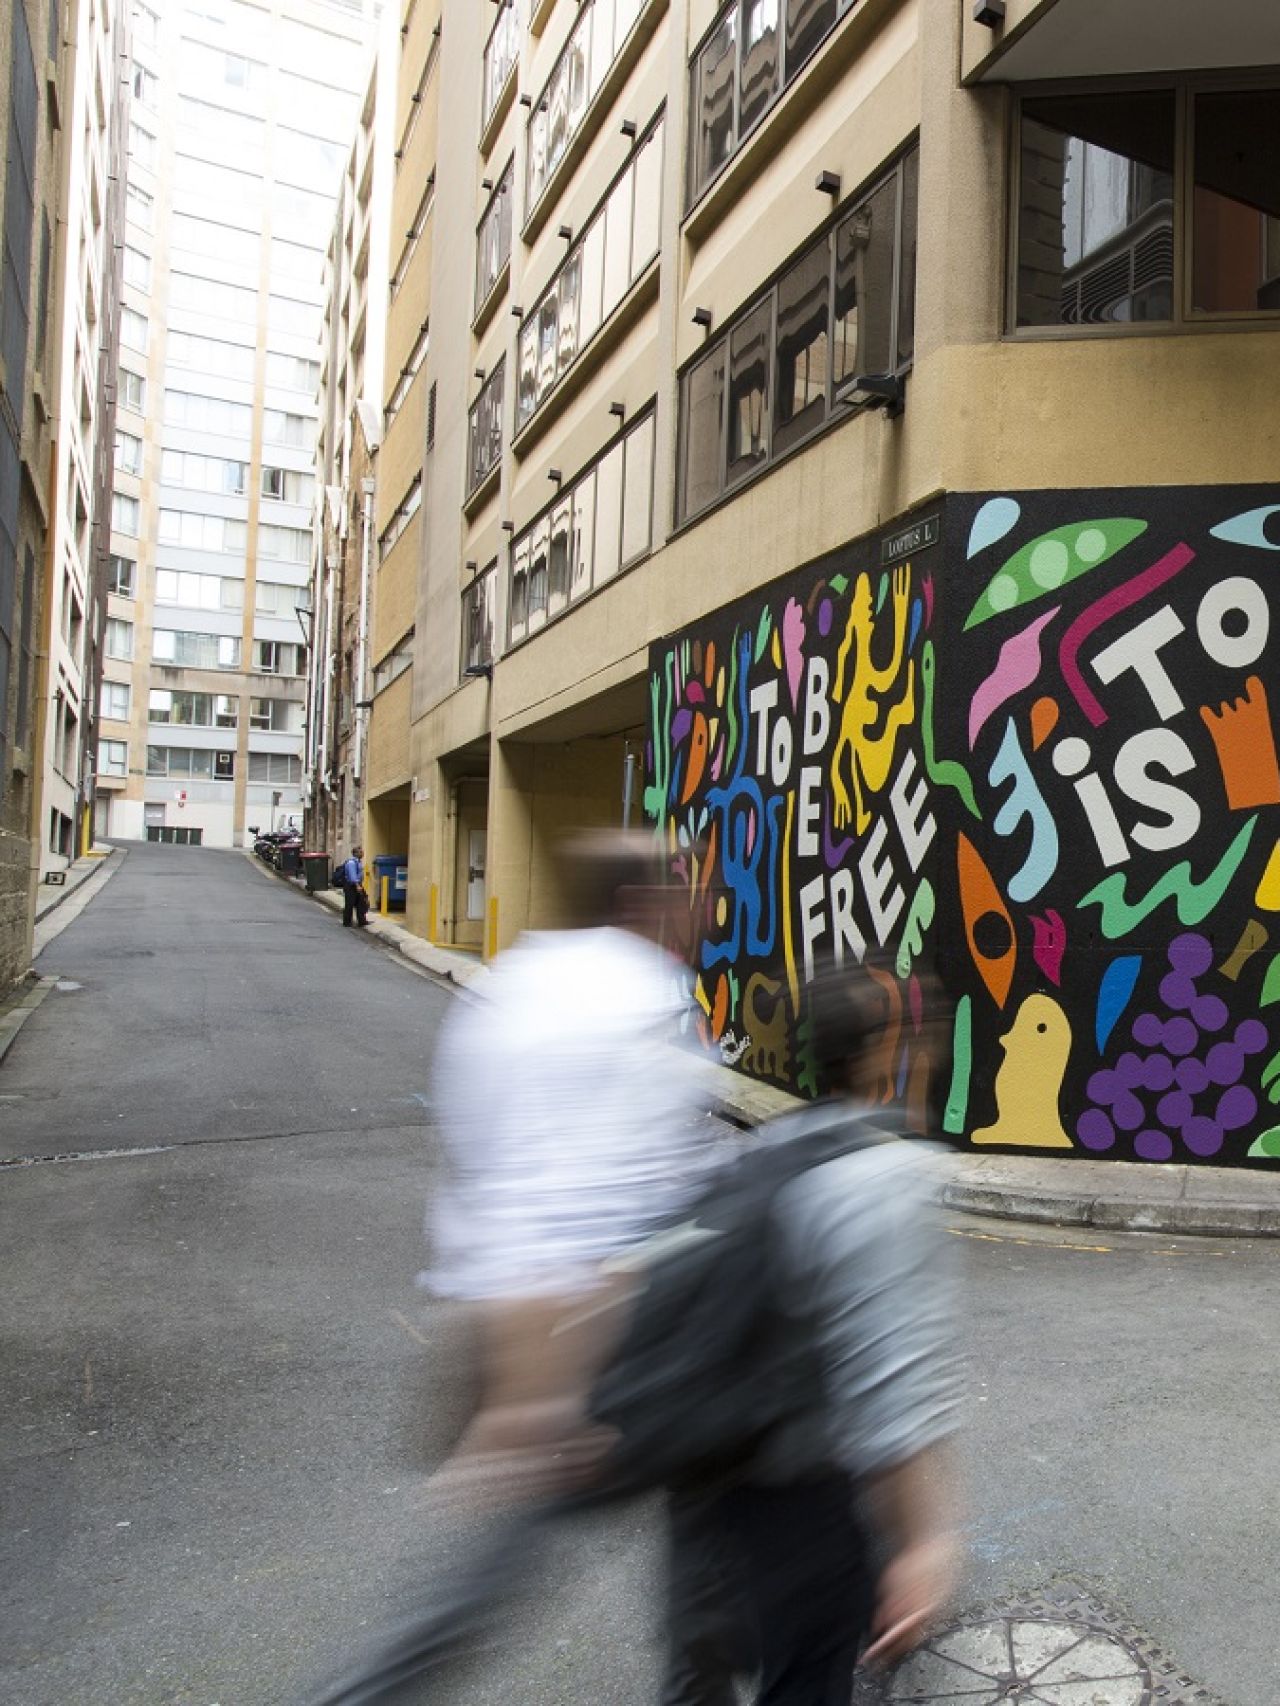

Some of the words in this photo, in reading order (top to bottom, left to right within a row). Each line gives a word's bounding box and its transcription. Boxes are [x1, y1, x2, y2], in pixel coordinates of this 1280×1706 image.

[1090, 576, 1270, 721] TO
[797, 655, 830, 857] BE
[800, 749, 937, 984] FREE
